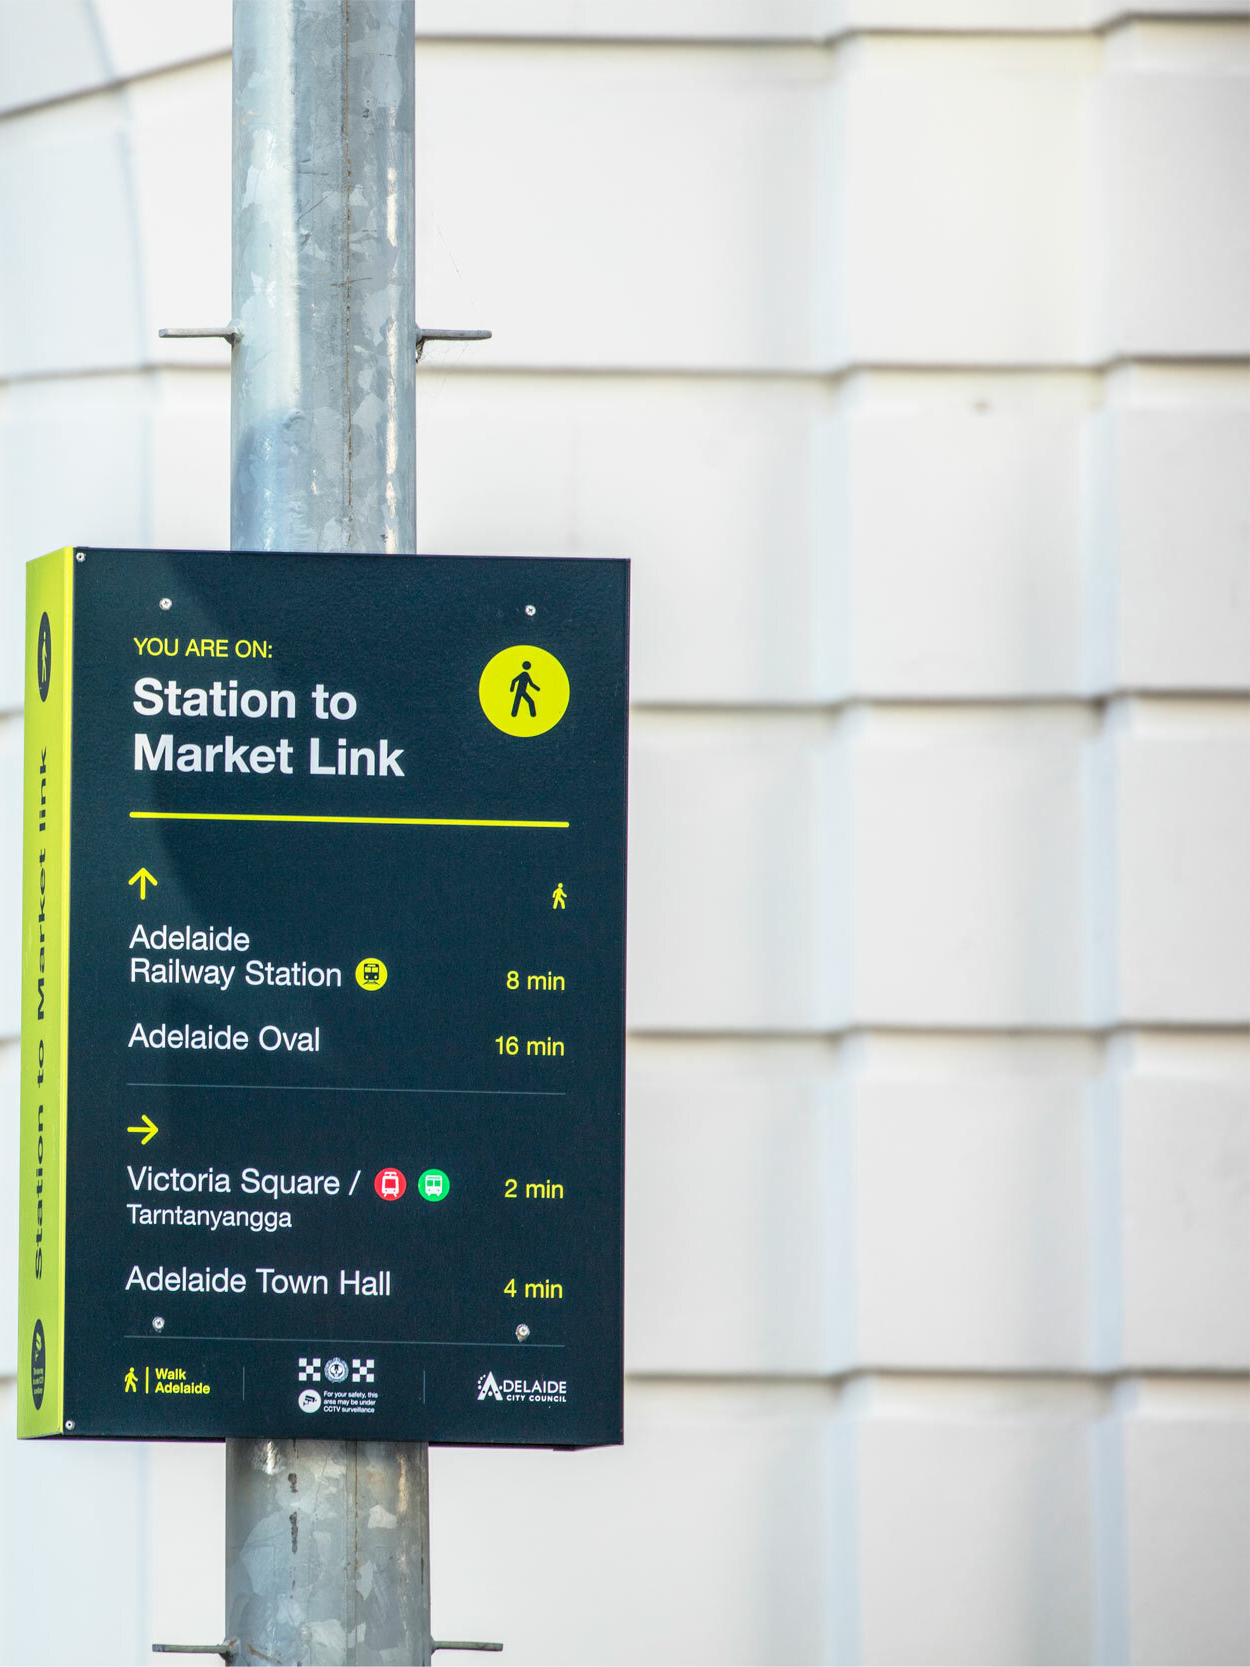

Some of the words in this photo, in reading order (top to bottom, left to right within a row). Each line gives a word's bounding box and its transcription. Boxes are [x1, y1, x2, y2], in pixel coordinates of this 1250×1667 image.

[134, 638, 178, 656] YOU
[185, 639, 228, 657] ARE
[235, 640, 272, 658] ON:
[133, 677, 295, 718] Station
[312, 684, 357, 720] to
[134, 733, 293, 774] Market
[310, 738, 405, 776] Link
[39, 746, 47, 831] link
[129, 924, 249, 951] Adelaide
[130, 957, 235, 990] Railway
[246, 960, 341, 986] Station
[507, 971, 519, 989] 8
[528, 971, 565, 990] min
[128, 1023, 248, 1050] Adelaide
[259, 1025, 319, 1051] Oval
[495, 1036, 519, 1055] 16
[527, 1037, 564, 1056] min
[38, 1040, 44, 1088] to
[35, 1105, 43, 1279] Station
[127, 1166, 231, 1192] Victoria
[241, 1168, 340, 1199] Square
[349, 1170, 361, 1195] /
[505, 1179, 517, 1198] 2
[526, 1180, 563, 1198] min
[127, 1204, 292, 1232] Tarntanyangga
[125, 1266, 246, 1292] Adelaide
[256, 1269, 328, 1294] Town
[341, 1270, 390, 1296] Hall
[504, 1279, 517, 1297] 4
[525, 1279, 562, 1298] min
[155, 1368, 186, 1380] Walk
[155, 1382, 210, 1394] Adelaide
[478, 1371, 566, 1401] ADELAIDE
[348, 1391, 366, 1399] safety,
